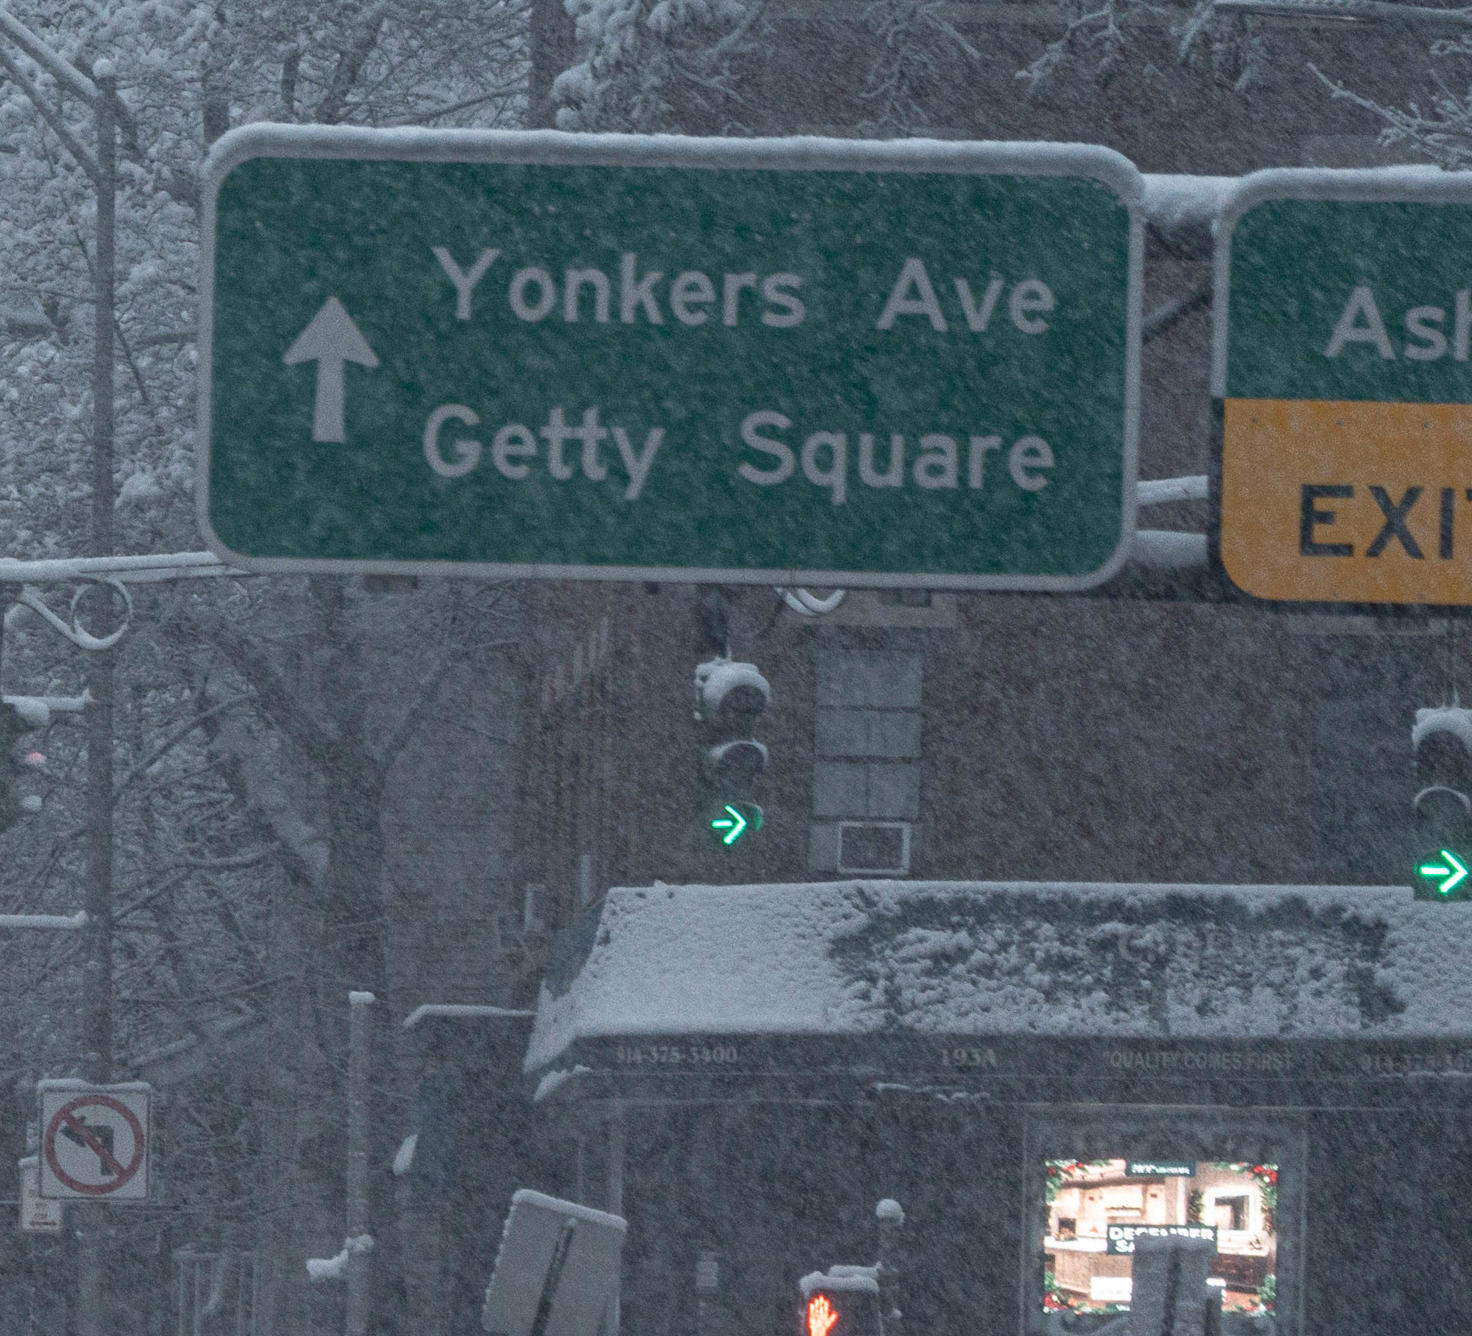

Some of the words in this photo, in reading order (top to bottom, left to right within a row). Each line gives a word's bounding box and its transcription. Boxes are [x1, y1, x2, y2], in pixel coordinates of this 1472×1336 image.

[432, 245, 806, 330] Yonkers
[877, 256, 1056, 336] Ave
[423, 402, 664, 502] Getty
[738, 409, 1057, 508] Square
